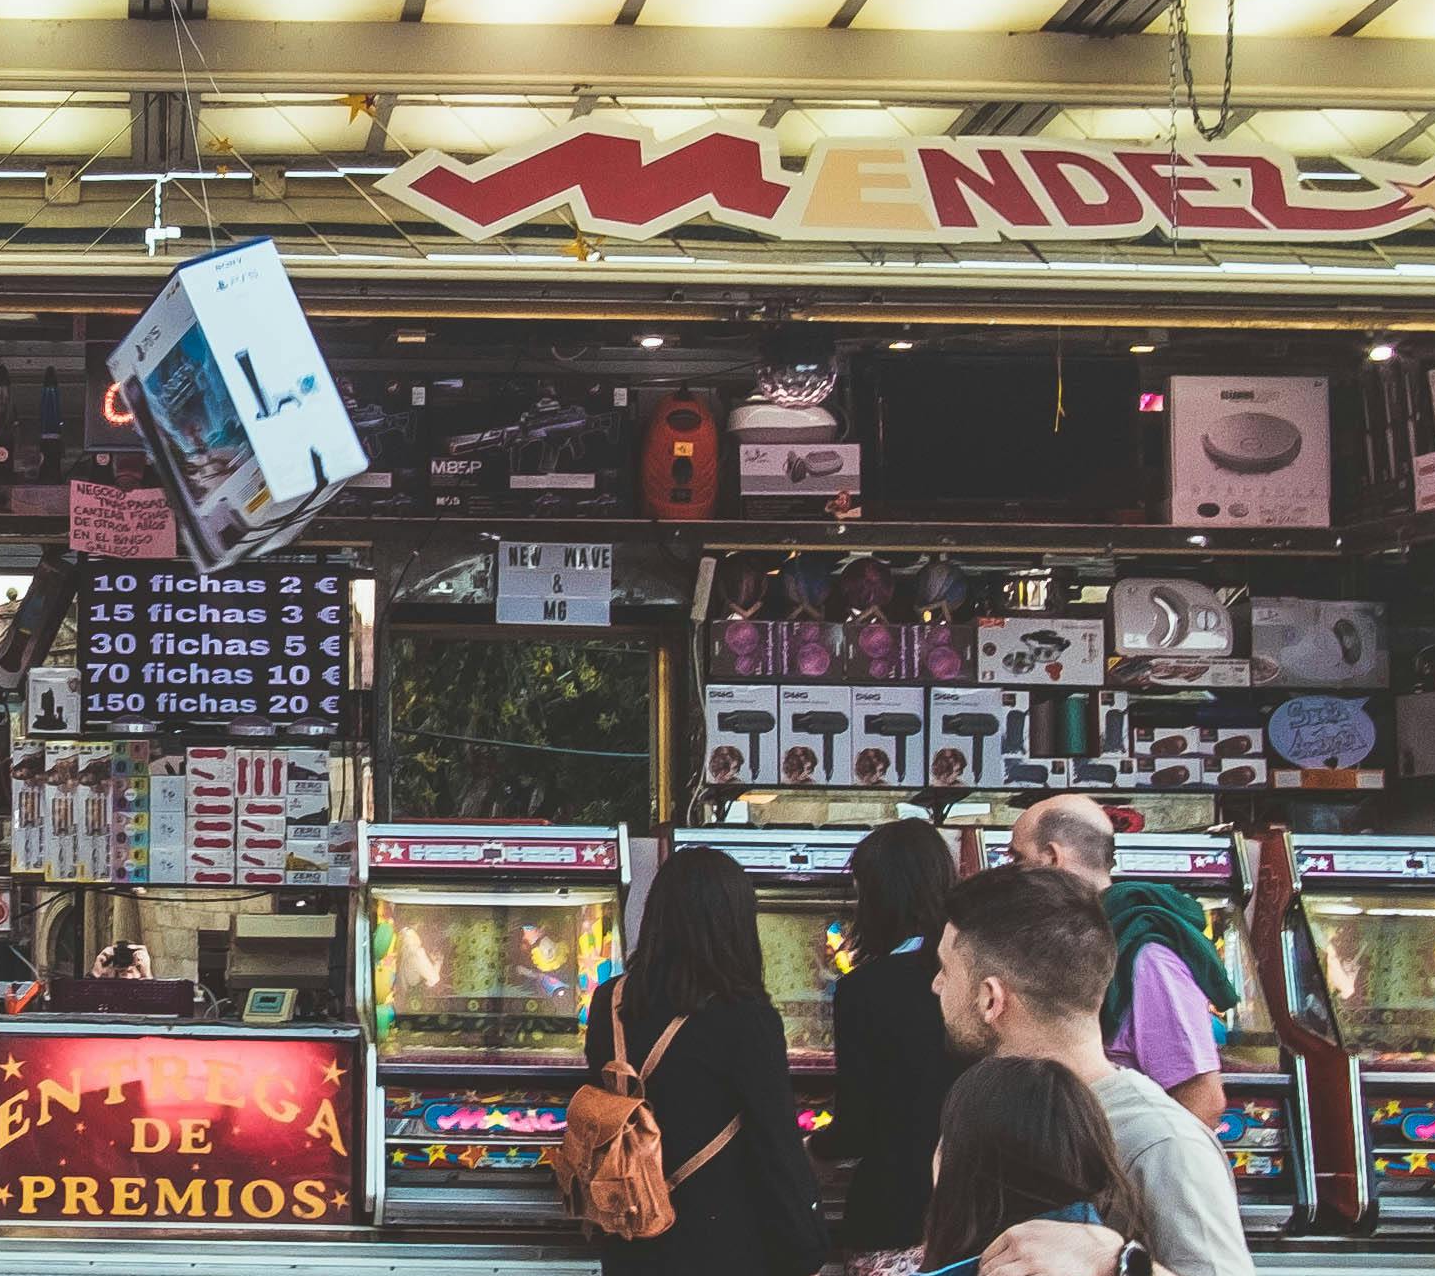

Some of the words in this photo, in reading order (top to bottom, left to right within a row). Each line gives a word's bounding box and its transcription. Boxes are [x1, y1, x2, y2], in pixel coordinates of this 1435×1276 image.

[76, 483, 127, 501] NEGOCIO
[74, 516, 90, 527] DE
[73, 529, 90, 540] EN
[95, 532, 109, 543] EL
[113, 534, 153, 545] BINGO
[508, 545, 542, 568] NEW
[564, 545, 611, 571] WAVE
[93, 574, 137, 593] 10
[150, 573, 266, 594] fichas
[279, 575, 302, 594] 2
[314, 576, 339, 594] €
[552, 573, 564, 593] &
[90, 604, 135, 622] 15
[147, 603, 267, 624] fichas
[281, 605, 304, 624] 3
[317, 605, 341, 624] €
[90, 633, 137, 655] 30
[150, 633, 270, 656] fichas
[284, 635, 307, 656] 5
[319, 636, 341, 657] €
[86, 662, 130, 684] 70
[142, 663, 254, 685] fichas
[268, 665, 311, 685] 10
[321, 665, 341, 685] €
[87, 694, 145, 713] 150
[156, 693, 258, 714] fichas
[269, 695, 309, 714] 20
[319, 695, 341, 714] €
[130, 1117, 213, 1156] DE
[17, 1174, 329, 1219] PREMIOS
